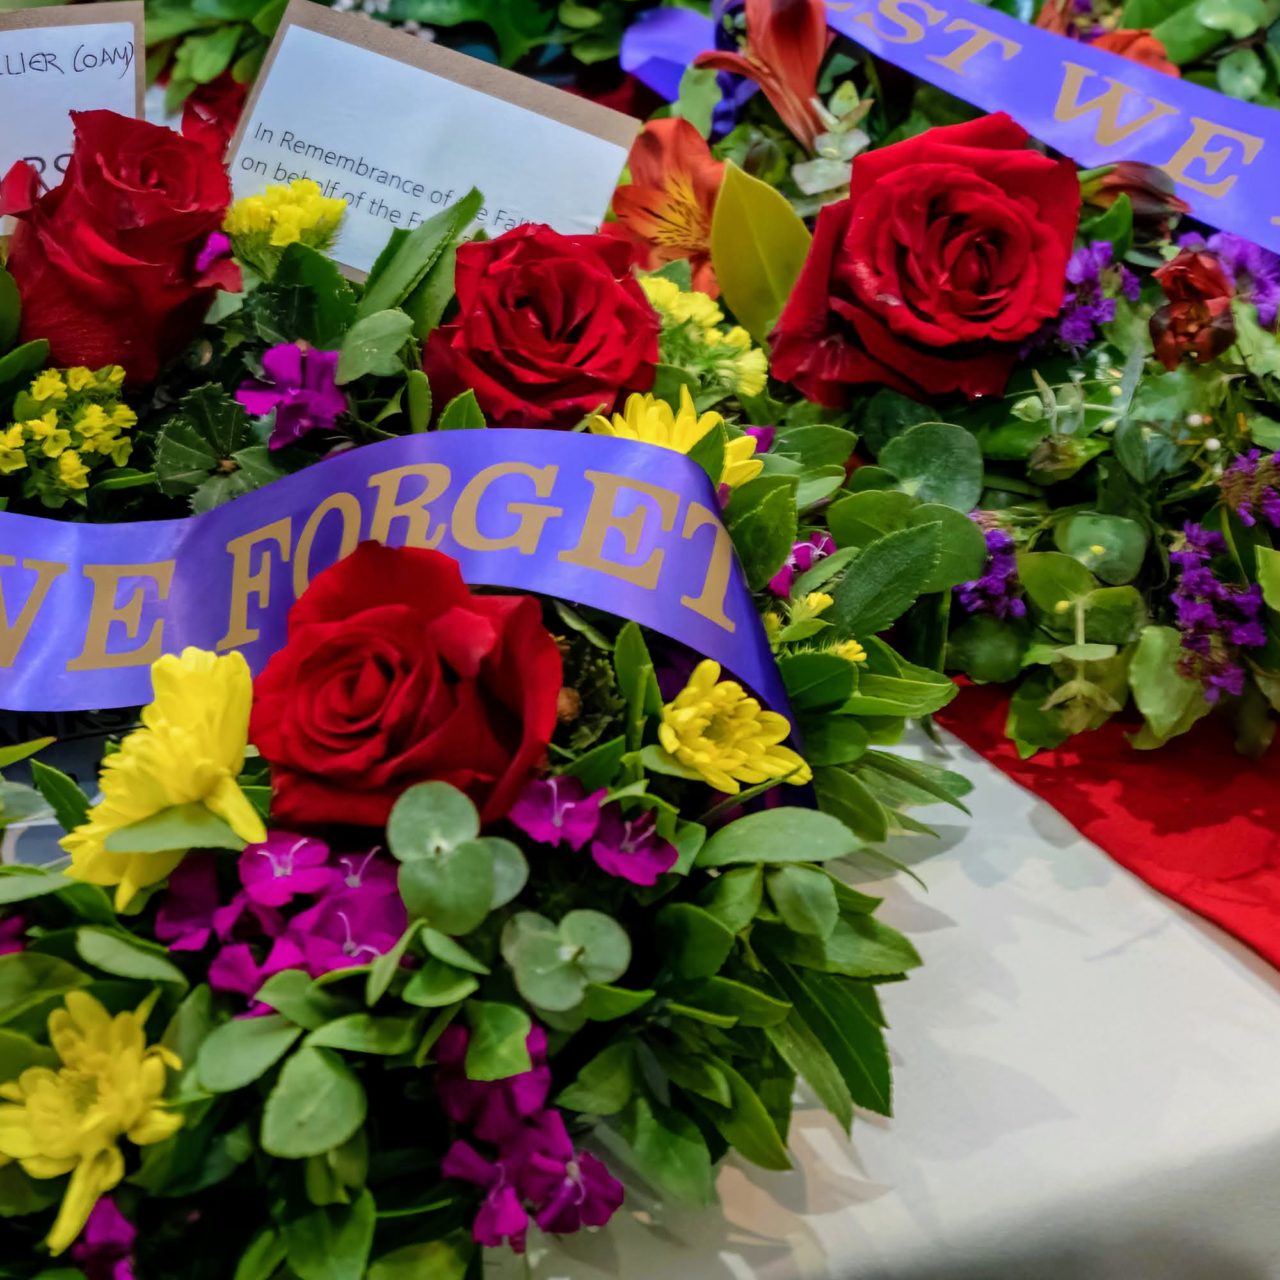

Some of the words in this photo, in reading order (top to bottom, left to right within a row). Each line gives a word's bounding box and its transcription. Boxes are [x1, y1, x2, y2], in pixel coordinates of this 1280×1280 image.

[0, 52, 64, 75] LIER
[254, 122, 274, 144] In
[279, 131, 425, 198] Remembrance
[430, 189, 455, 207] of
[1053, 61, 1264, 199] WE
[241, 156, 267, 176] on
[342, 191, 367, 208] of
[369, 198, 401, 223] the
[216, 462, 735, 652] FORGET
